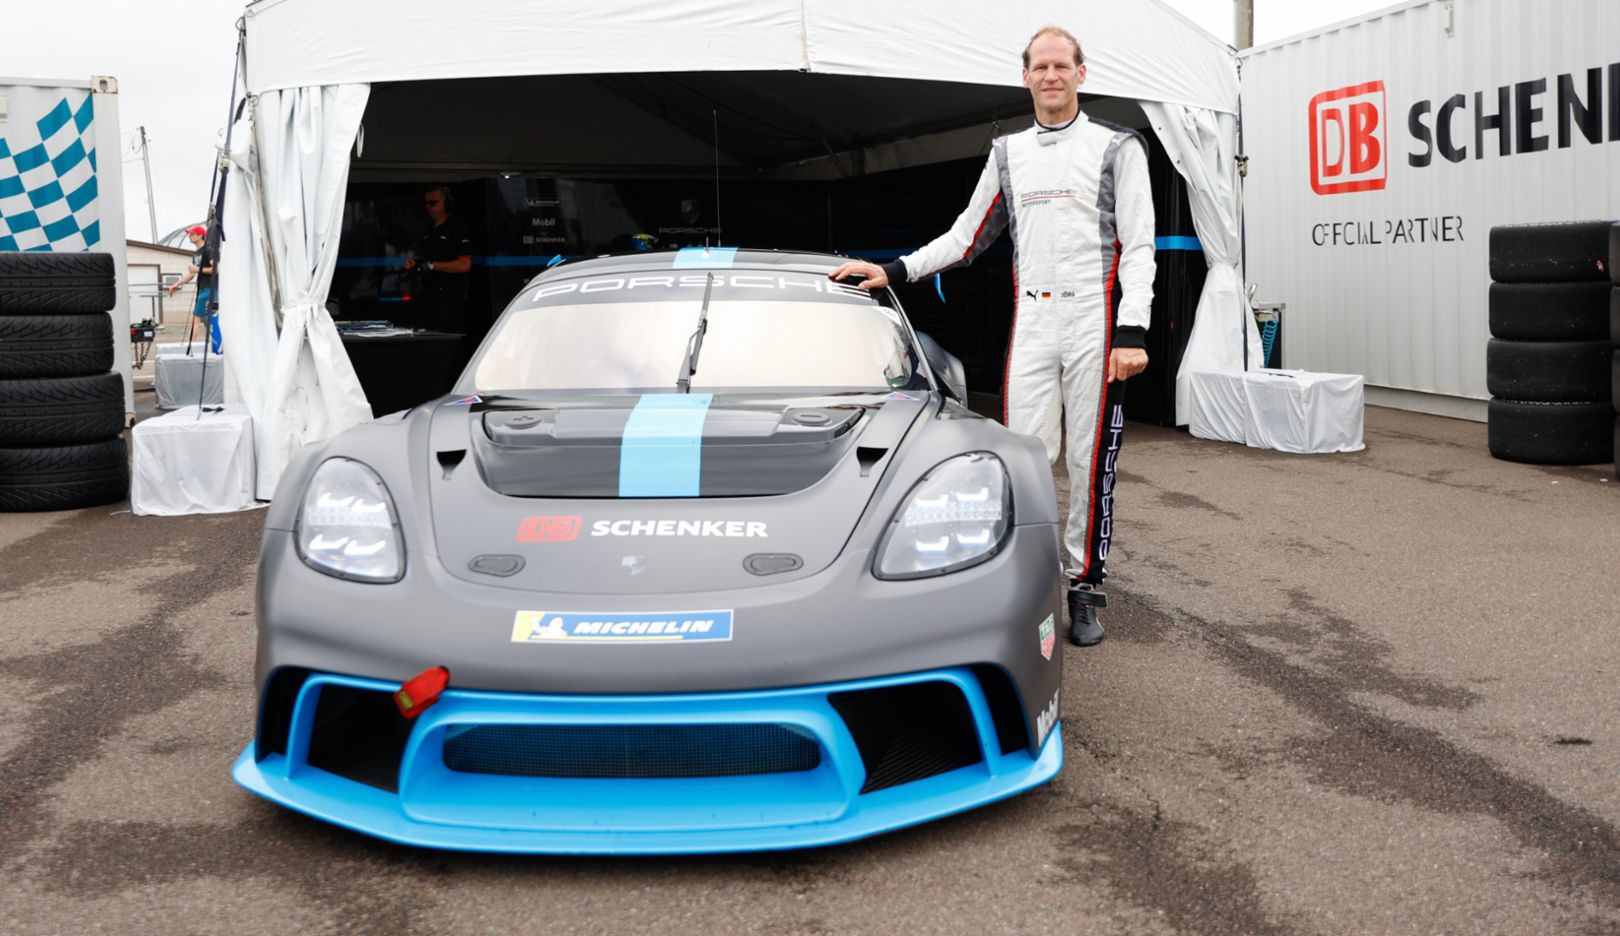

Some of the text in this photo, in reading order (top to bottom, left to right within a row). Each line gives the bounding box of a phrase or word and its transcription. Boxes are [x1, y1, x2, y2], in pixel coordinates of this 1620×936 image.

[1320, 100, 1382, 178] DB
[1385, 215, 1464, 244] PARTNER
[532, 275, 872, 302] PORSCHE
[1099, 404, 1124, 561] PORSCHE
[591, 519, 769, 538] SCHENKER
[573, 619, 714, 635] MICHELIN
